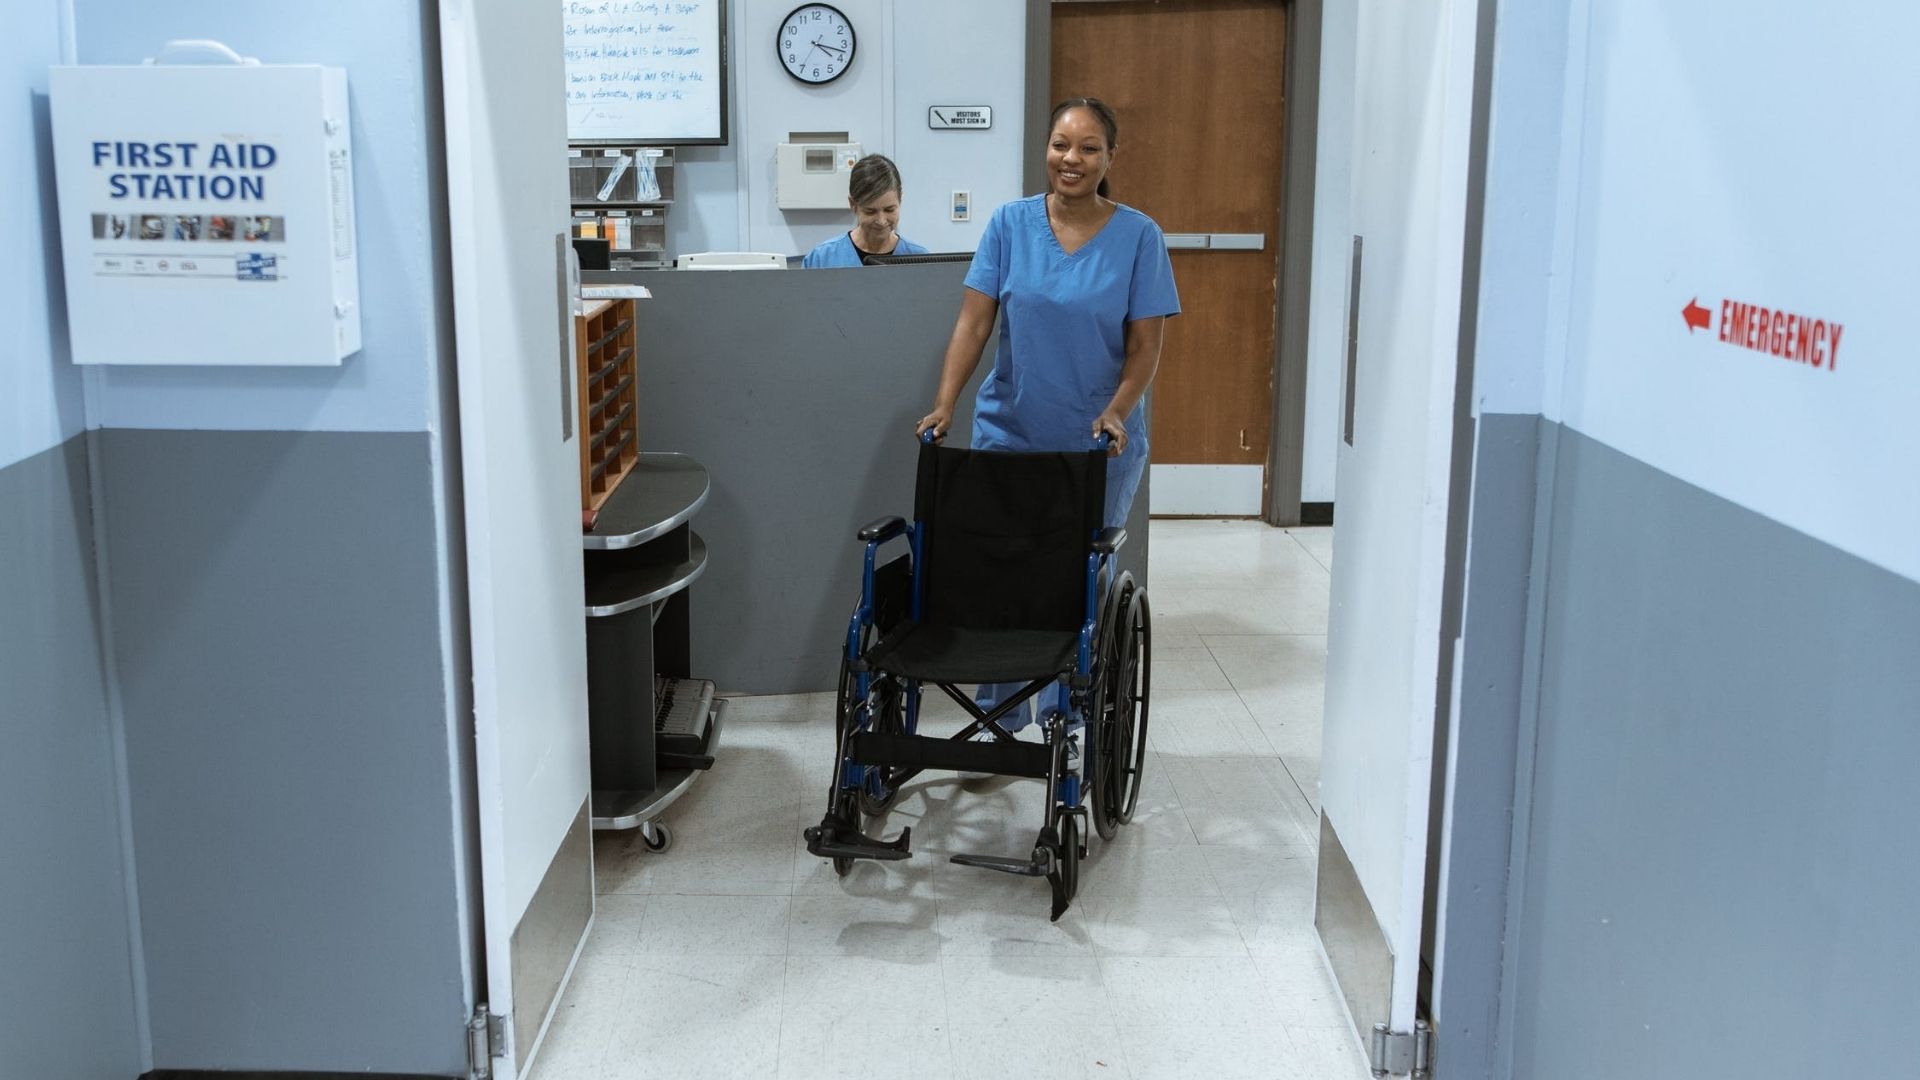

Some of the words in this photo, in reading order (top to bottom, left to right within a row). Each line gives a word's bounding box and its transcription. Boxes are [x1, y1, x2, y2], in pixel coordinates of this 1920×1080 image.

[799, 15, 807, 24] 11
[829, 15, 833, 24] 1
[811, 10, 821, 20] 12
[787, 25, 798, 35] 10
[836, 25, 844, 35] 2
[785, 40, 792, 49] 9
[840, 39, 848, 49] 3
[789, 54, 796, 63] 8
[837, 54, 844, 63] 4
[799, 64, 806, 74] 7
[826, 64, 834, 74] 5
[812, 68, 820, 78] 6
[92, 141, 198, 168] FIRST
[208, 143, 278, 169] AID
[109, 173, 265, 201] STATION
[1719, 299, 1843, 372] EMERGENCY
